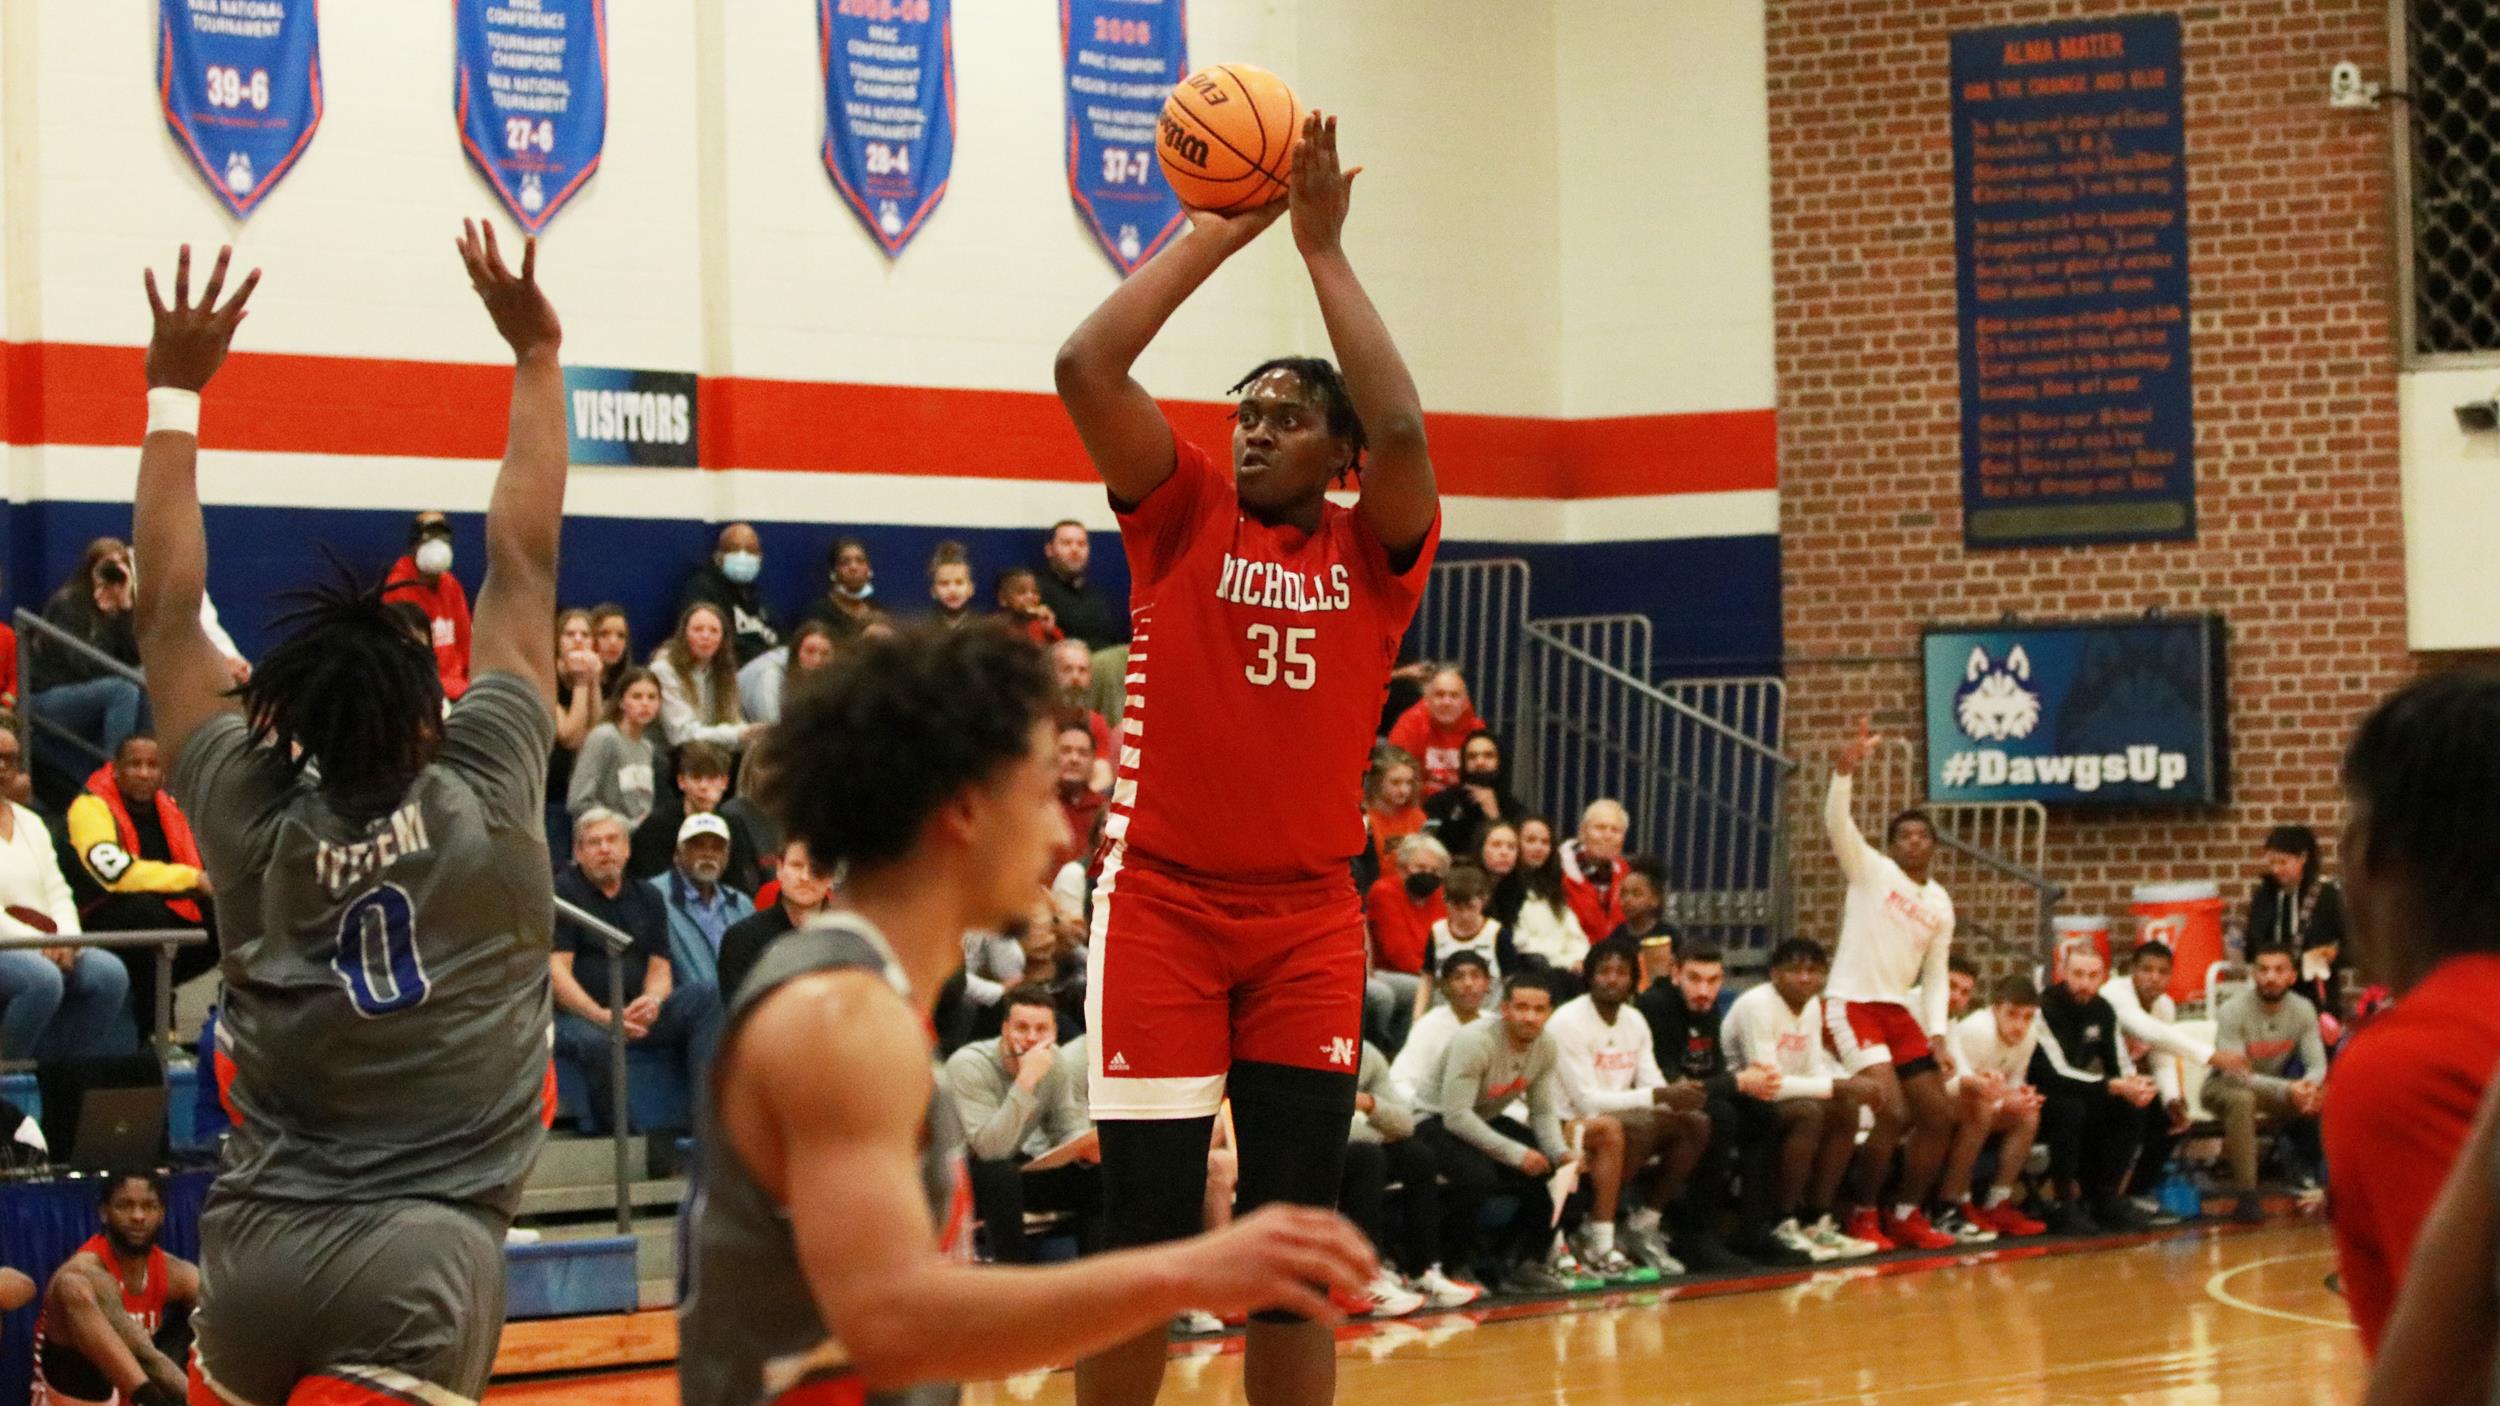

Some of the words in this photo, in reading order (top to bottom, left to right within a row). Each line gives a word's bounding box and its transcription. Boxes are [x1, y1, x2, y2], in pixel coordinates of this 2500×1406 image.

[192, 13, 281, 38] TOURNAMENT
[2058, 32, 2125, 59] MATER
[206, 63, 270, 112] 39-6
[506, 116, 554, 154] 27-6
[1102, 148, 1150, 186] 37-7
[572, 389, 690, 445] VISITORS
[1215, 552, 1350, 612] NICHOLLS
[1245, 622, 1317, 690] 35
[1941, 744, 2187, 792] #DawgsUp
[330, 880, 431, 1019] 0
